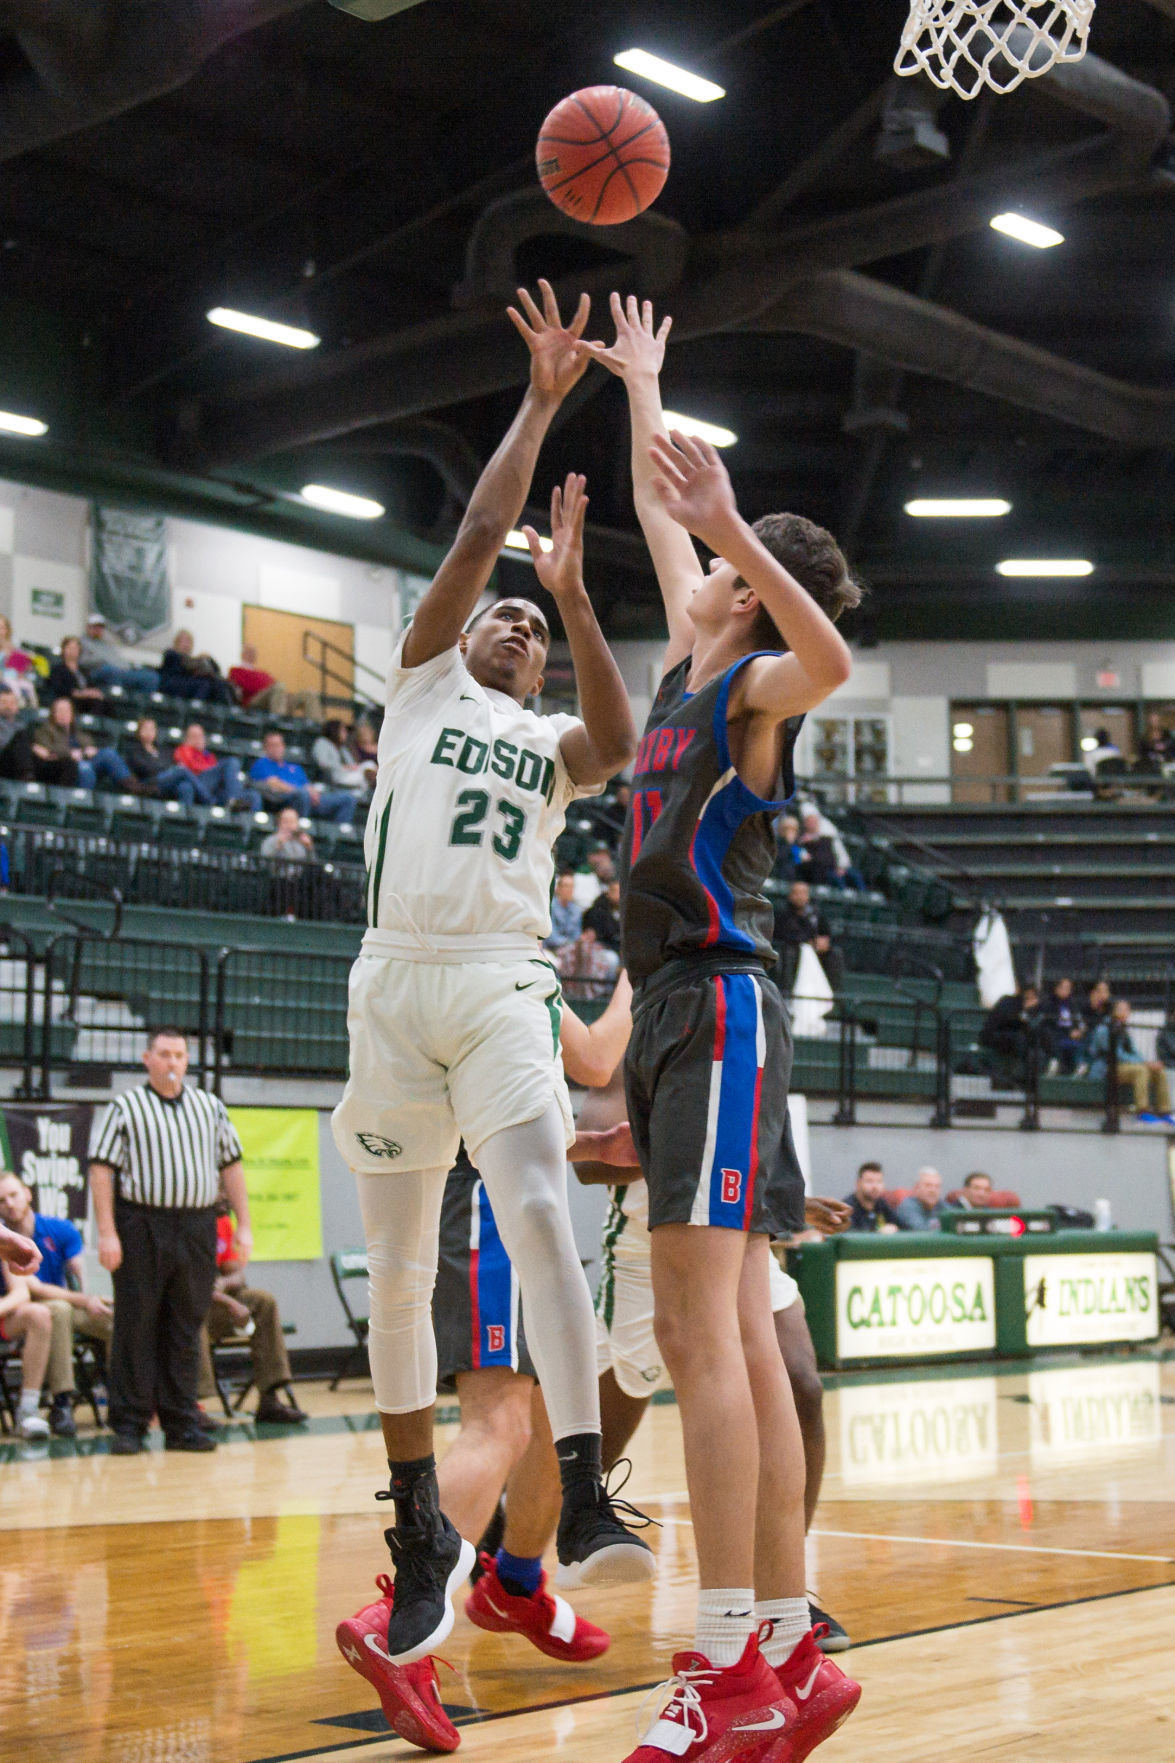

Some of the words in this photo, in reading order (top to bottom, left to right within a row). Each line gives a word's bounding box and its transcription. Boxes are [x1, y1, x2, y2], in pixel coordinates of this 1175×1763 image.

[430, 727, 557, 808] EDSON
[449, 787, 528, 863] 23
[721, 1167, 742, 1204] B
[846, 1281, 988, 1329] CATOOSA
[1058, 1275, 1150, 1316] INDIANS
[486, 1325, 505, 1352] B
